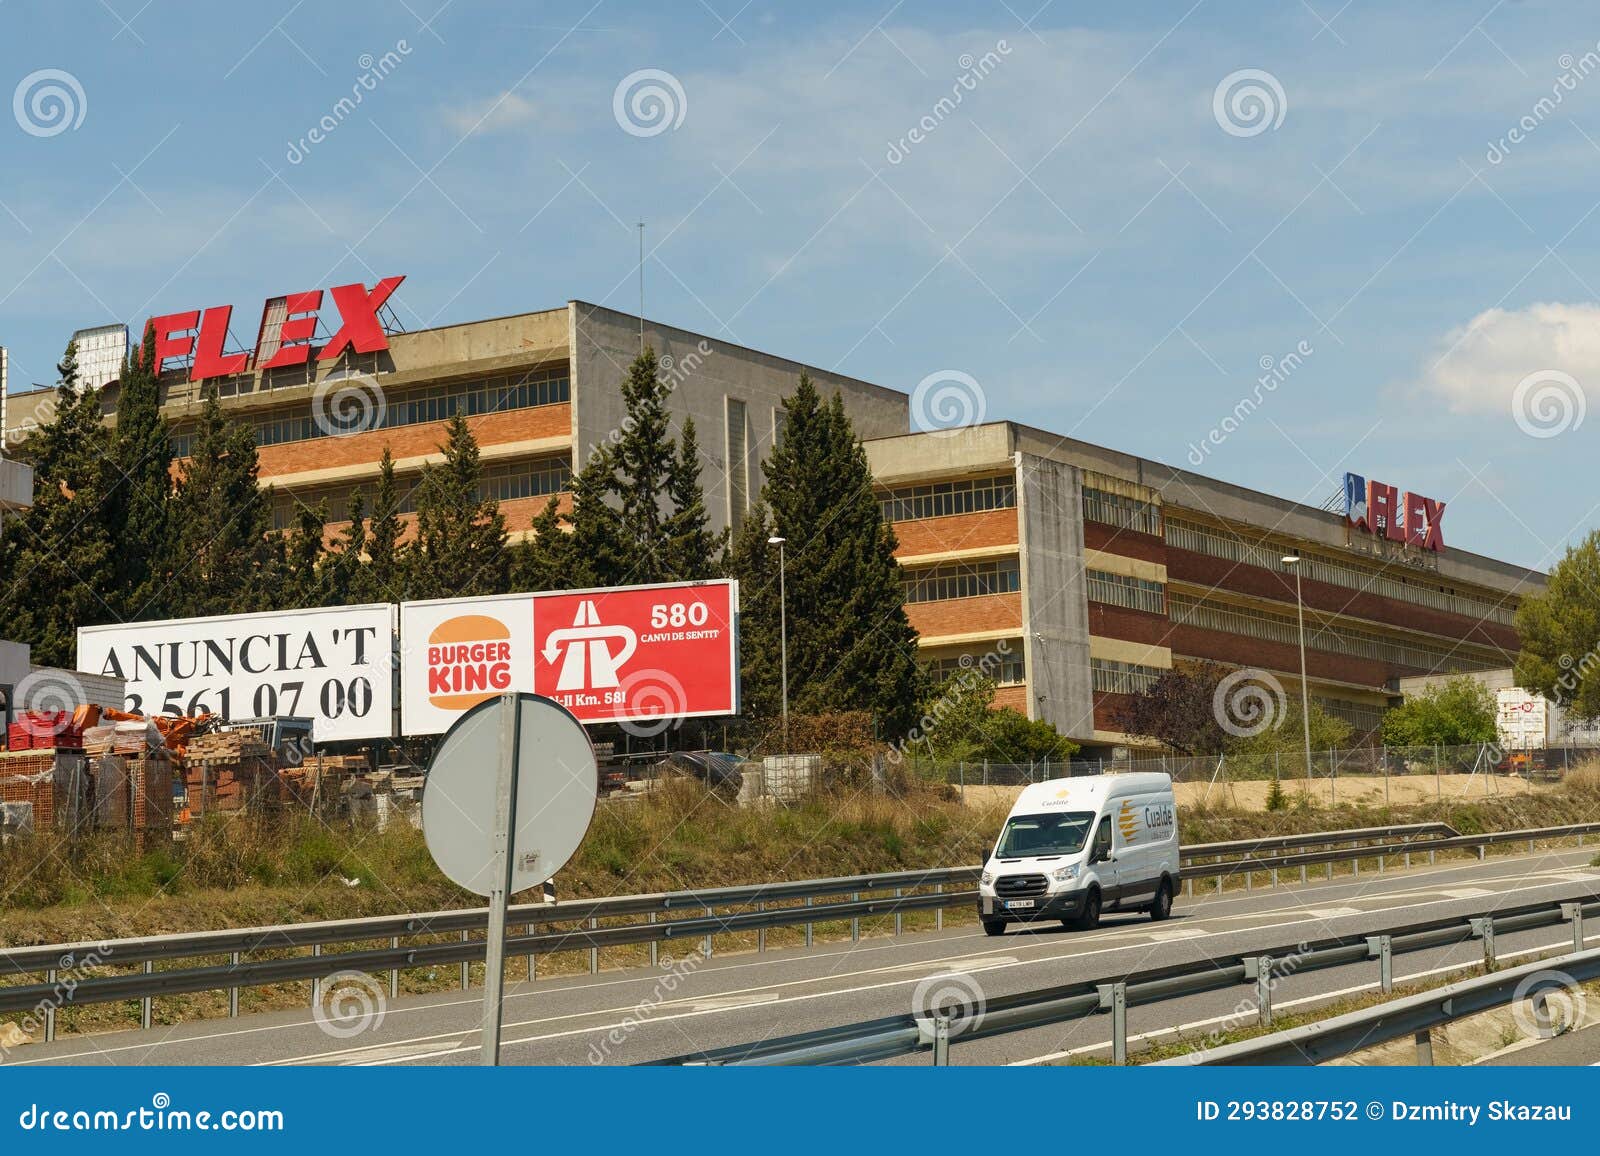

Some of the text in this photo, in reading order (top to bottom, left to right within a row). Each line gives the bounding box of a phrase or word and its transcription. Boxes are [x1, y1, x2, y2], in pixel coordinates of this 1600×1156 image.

[139, 275, 407, 381] FLEX
[1367, 479, 1447, 553] FLEX
[651, 601, 709, 629] 580
[640, 629, 720, 643] CANVI DE SENTIT
[100, 626, 376, 683] ANUNCIA'T
[428, 641, 512, 666] BURGER
[428, 662, 512, 694] KING
[161, 686, 231, 726] 561
[253, 681, 305, 717] 07
[319, 676, 373, 720] 00
[575, 693, 602, 707] Km.
[604, 691, 627, 705] 581
[1145, 804, 1173, 828] Cualde
